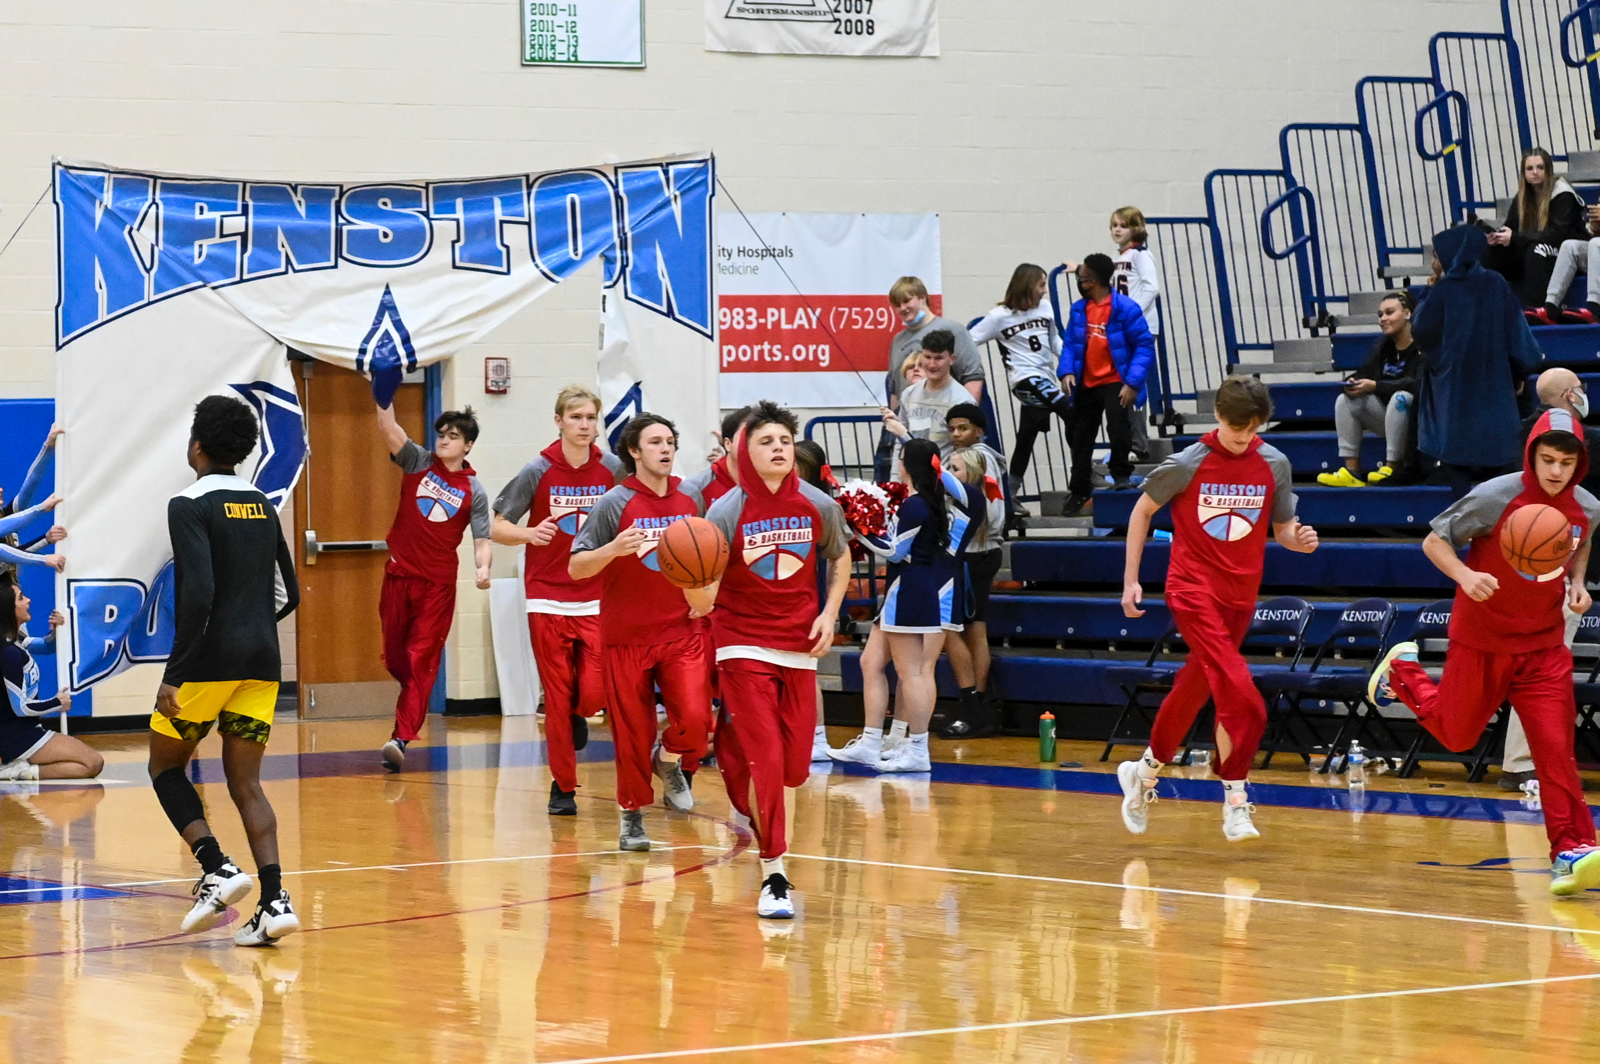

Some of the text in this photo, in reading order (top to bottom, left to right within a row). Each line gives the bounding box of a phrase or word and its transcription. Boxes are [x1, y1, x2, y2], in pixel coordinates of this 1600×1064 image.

[530, 3, 577, 17] 2010-11
[736, 6, 831, 17] SPORTSMANSHIP
[833, 0, 874, 14] 2007
[530, 19, 577, 33] 2011-12
[834, 18, 875, 35] 2008
[529, 34, 578, 48] 2012-13
[53, 157, 715, 352] KENSTON
[737, 245, 794, 261] Hospitals
[719, 306, 896, 333] 983-PLAY (7529)
[1028, 335, 1042, 353] 8
[722, 341, 830, 367] ports.org
[550, 485, 607, 496] KENSTON
[1201, 483, 1267, 496] KENSTON
[1216, 498, 1262, 507] BASKETBALL
[224, 502, 268, 519] CONWELL
[742, 516, 812, 536] KENSTON
[761, 530, 811, 544] BASKETBALL
[1254, 609, 1302, 621] KENSTON
[1341, 610, 1386, 622] KENSTON
